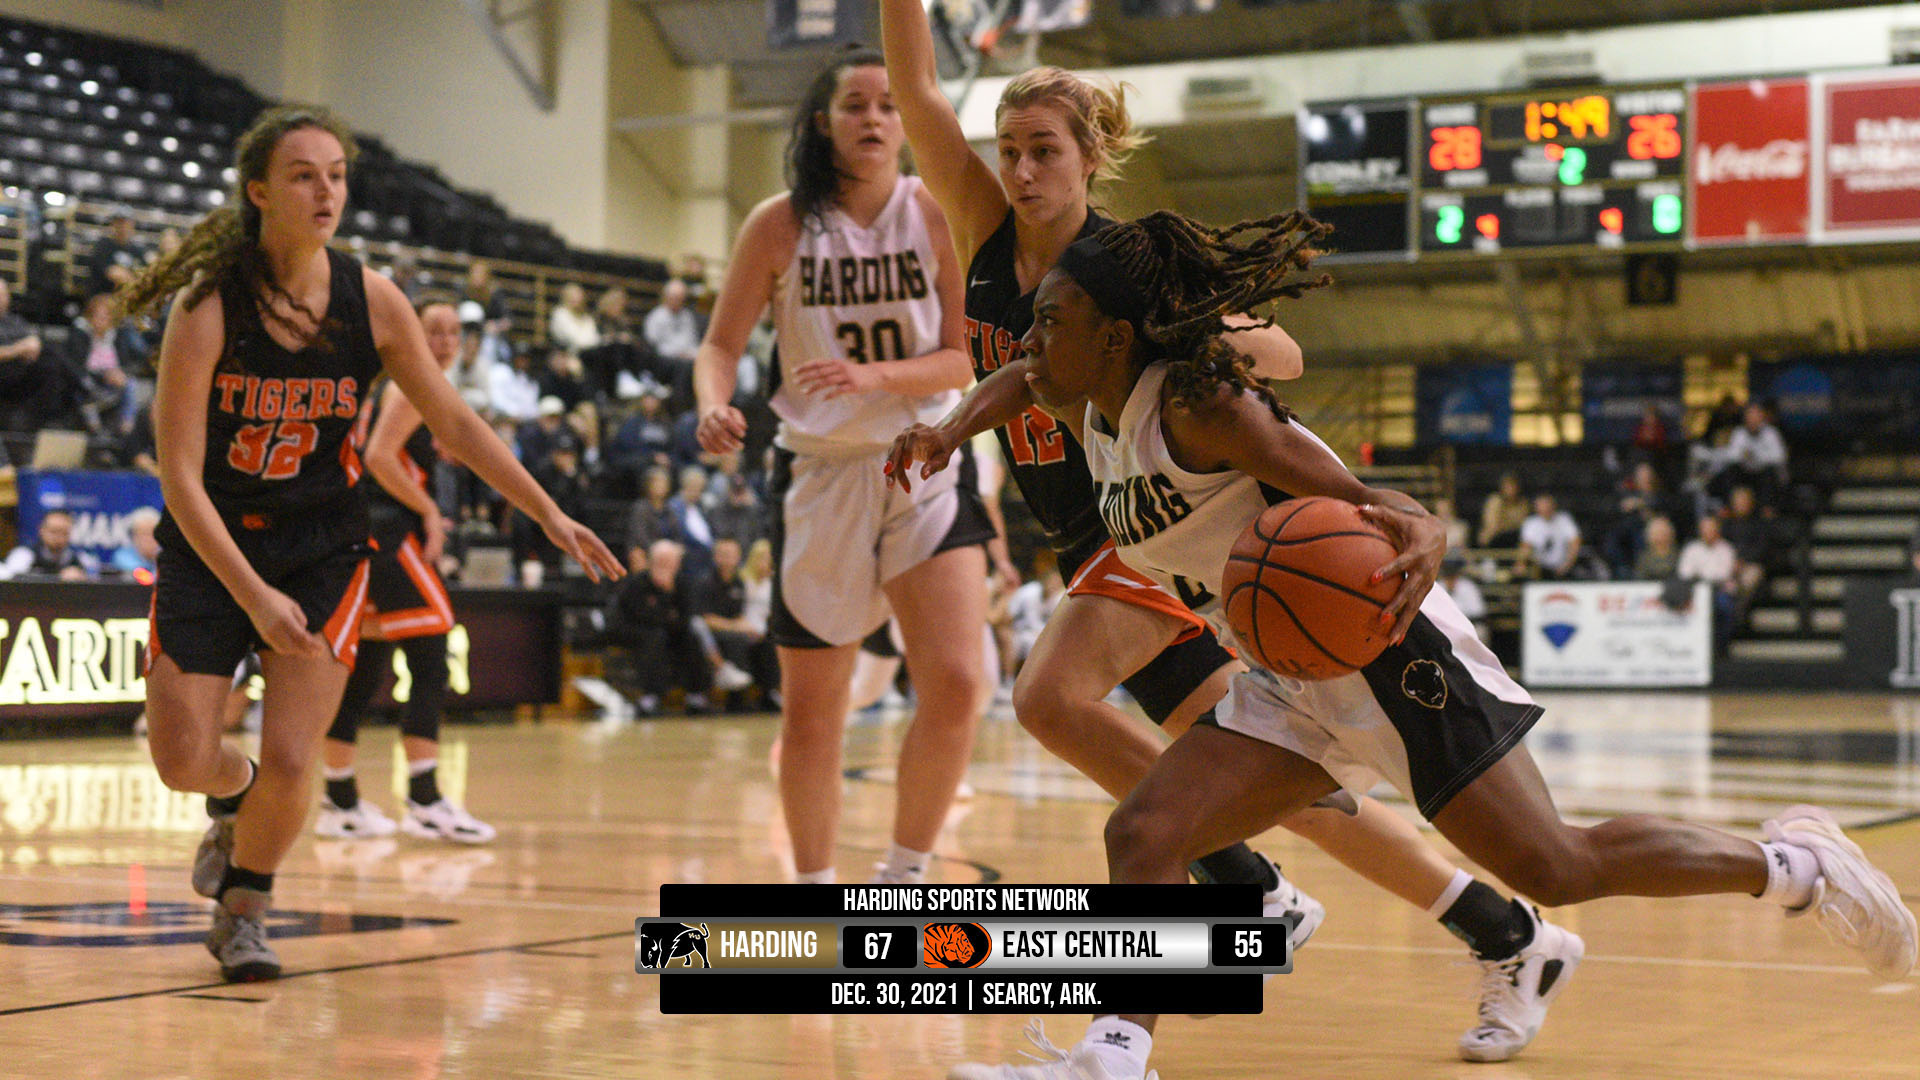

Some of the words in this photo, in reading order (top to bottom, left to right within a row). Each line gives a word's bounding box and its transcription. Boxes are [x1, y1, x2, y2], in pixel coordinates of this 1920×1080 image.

[1429, 126, 1482, 171] 28
[1628, 114, 1682, 160] 26
[1559, 147, 1587, 186] 2
[1436, 205, 1465, 244] 2
[800, 250, 927, 306] HARDING
[215, 372, 358, 421] TIGERS
[0, 616, 150, 704] ARD
